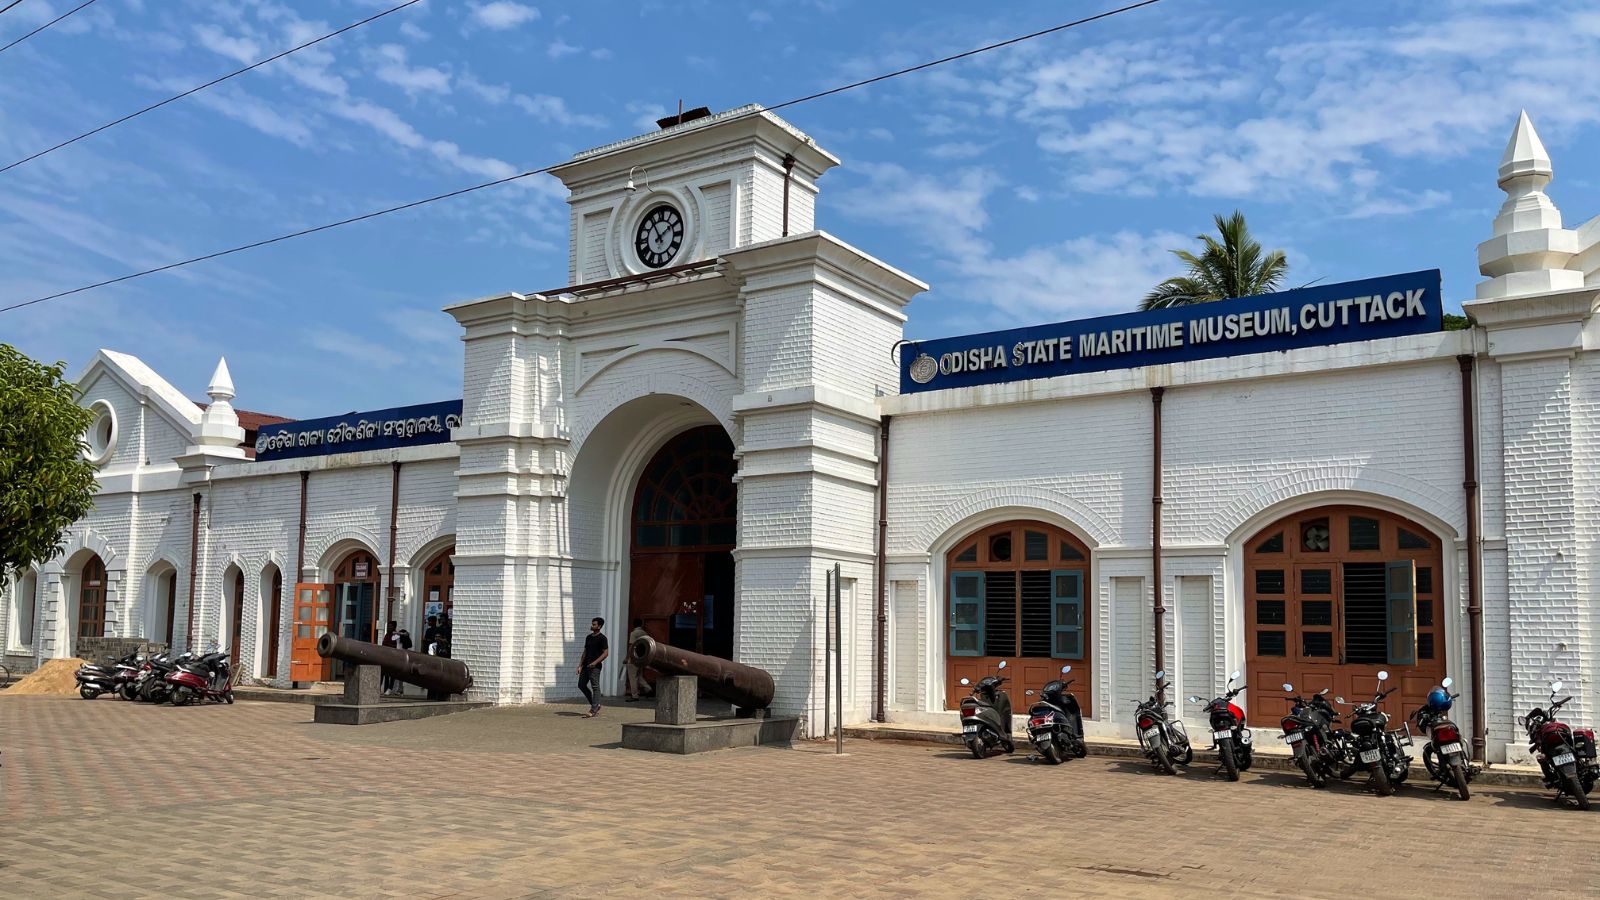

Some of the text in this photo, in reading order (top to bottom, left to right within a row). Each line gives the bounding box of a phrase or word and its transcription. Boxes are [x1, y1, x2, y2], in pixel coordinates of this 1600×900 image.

[938, 344, 1007, 376] ODISHA
[1012, 337, 1072, 367] STATE
[1079, 321, 1184, 358] MARITIME
[1299, 288, 1426, 331] CUTTACK
